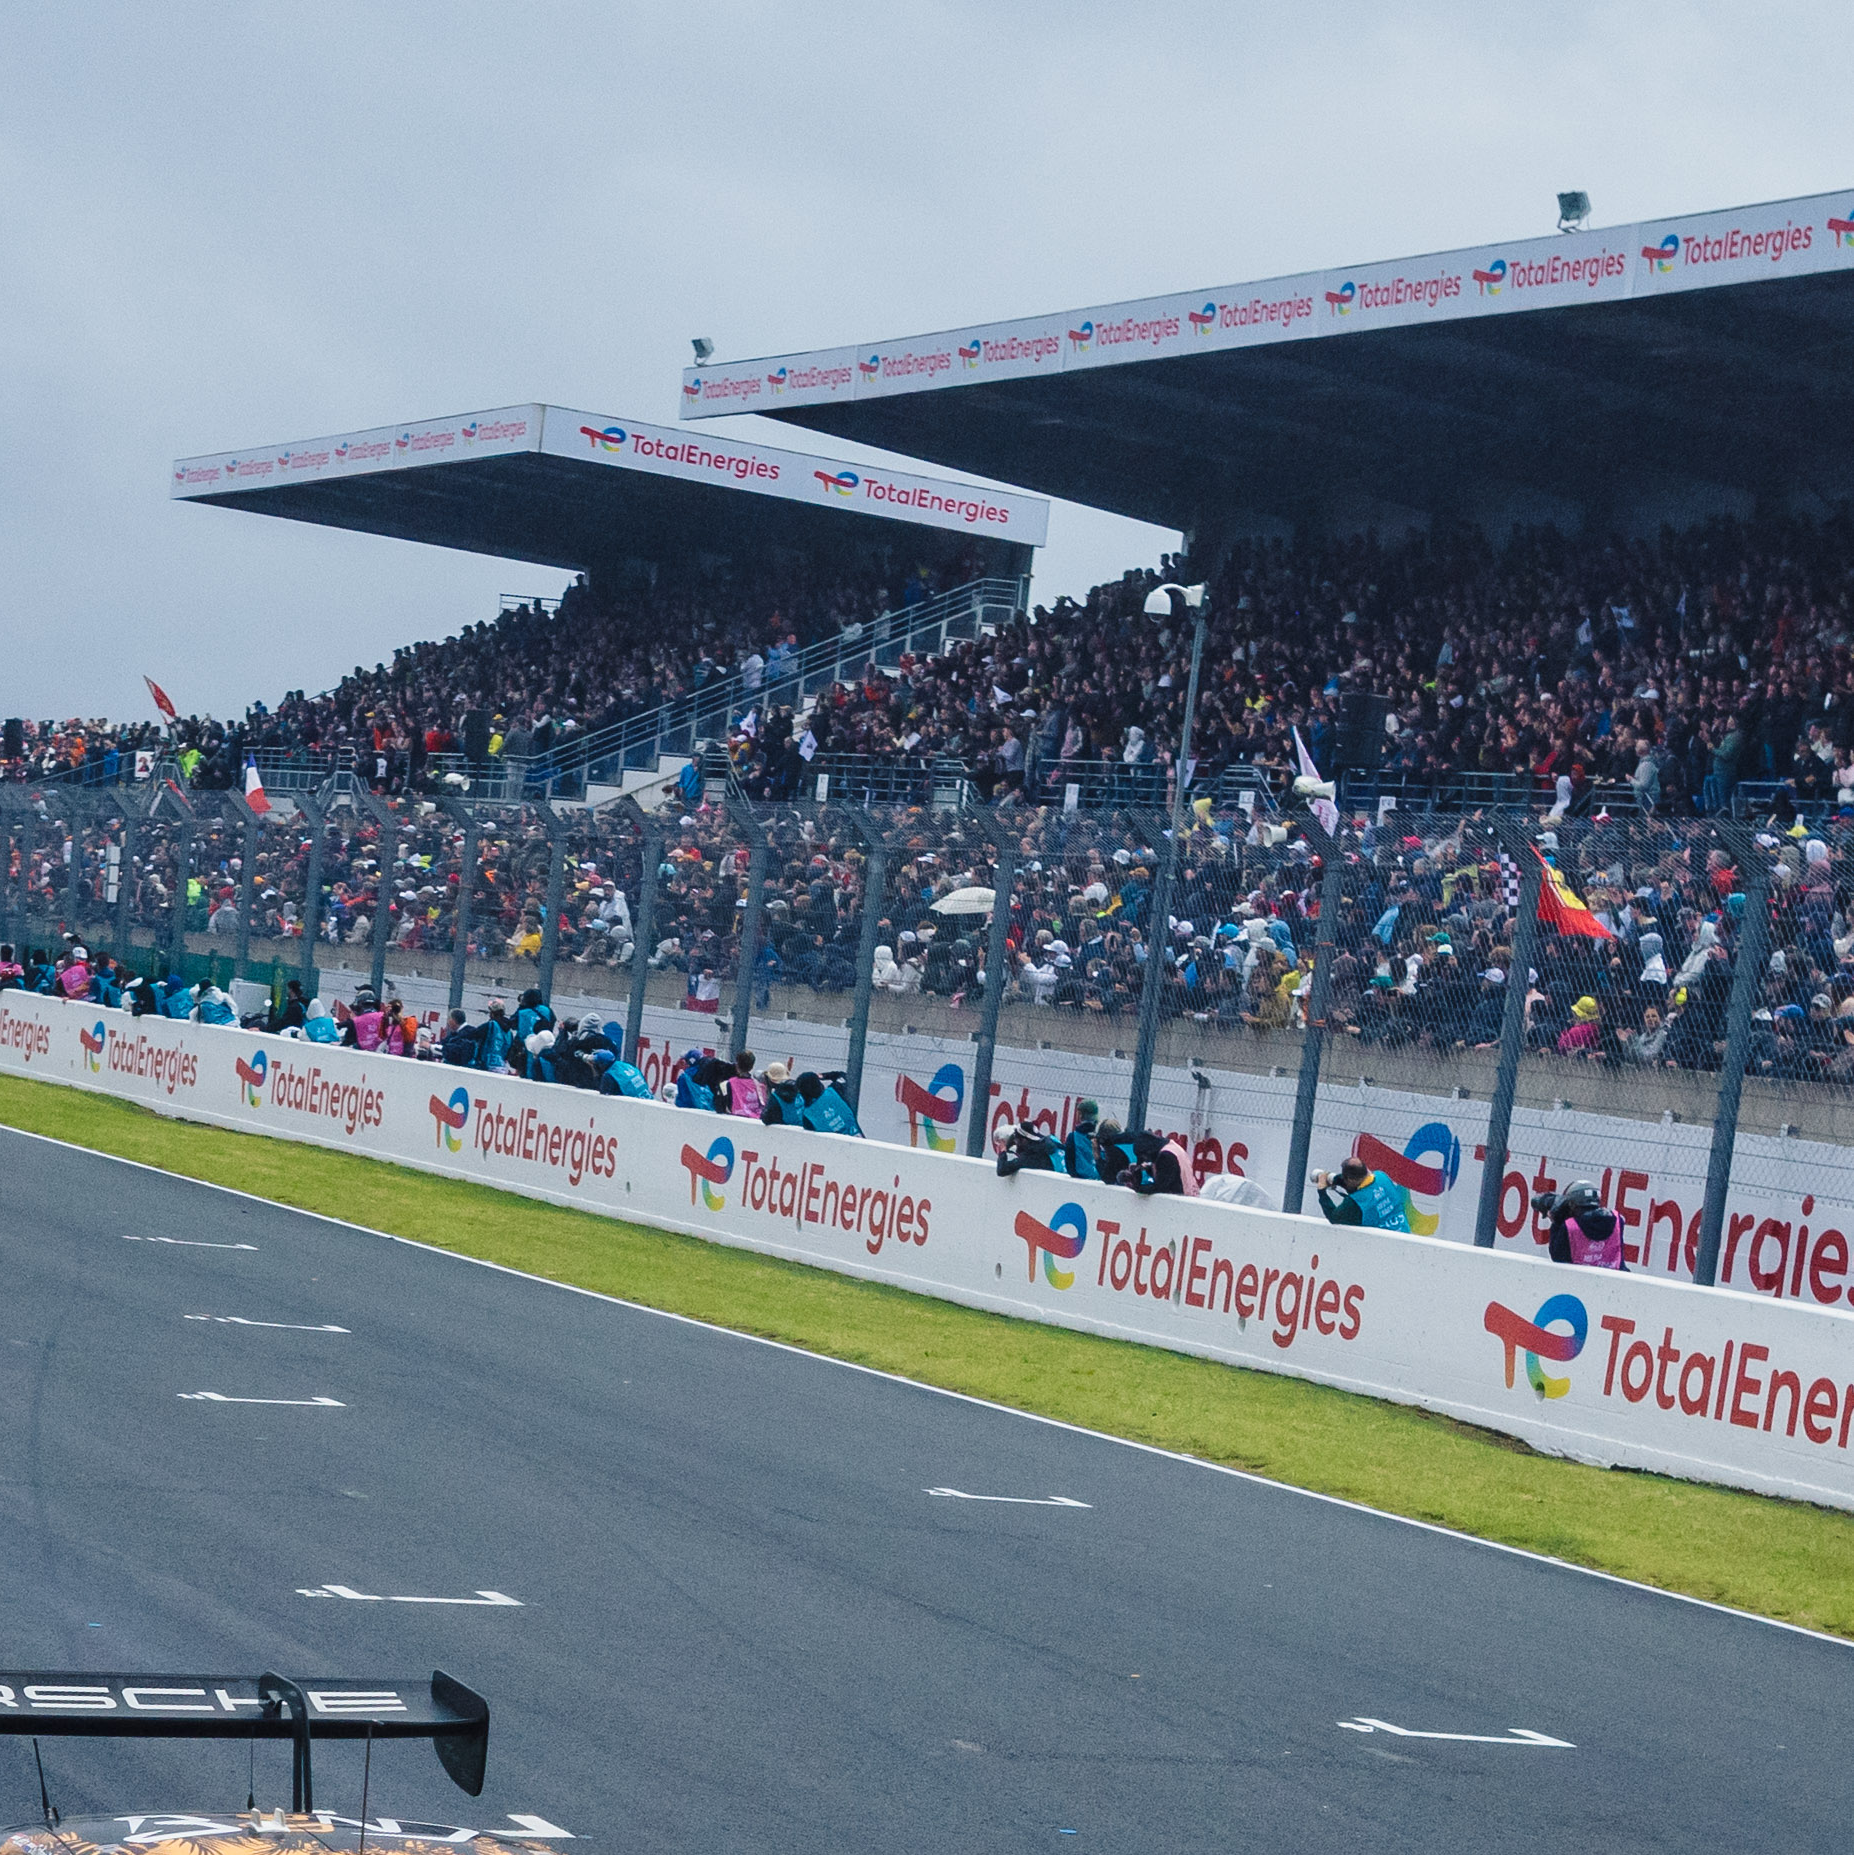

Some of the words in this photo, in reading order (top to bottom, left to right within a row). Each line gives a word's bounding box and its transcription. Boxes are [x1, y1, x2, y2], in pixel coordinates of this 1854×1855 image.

[1683, 222, 1813, 267] TotalEnergies
[1509, 249, 1625, 290] TotalEnergies
[1218, 294, 1313, 330] TotalEnergies
[1357, 273, 1461, 311] TotalEnergies
[982, 332, 1060, 365] TotalEnergies
[1095, 312, 1181, 347] TotalEnergies
[787, 364, 852, 391] TotalEnergies
[881, 350, 952, 379] TotalEnergies
[701, 376, 762, 401] TotalEnergies
[631, 434, 780, 480] TotalEnergies
[863, 479, 1009, 524] TotalEnergies
[108, 1030, 197, 1094] TotalEnergies
[270, 1060, 384, 1135] TotalEnergies
[474, 1099, 618, 1186] TotalEnergies
[740, 1150, 932, 1255] TotalEnergies
[1096, 1219, 1365, 1348] TotalEnergies
